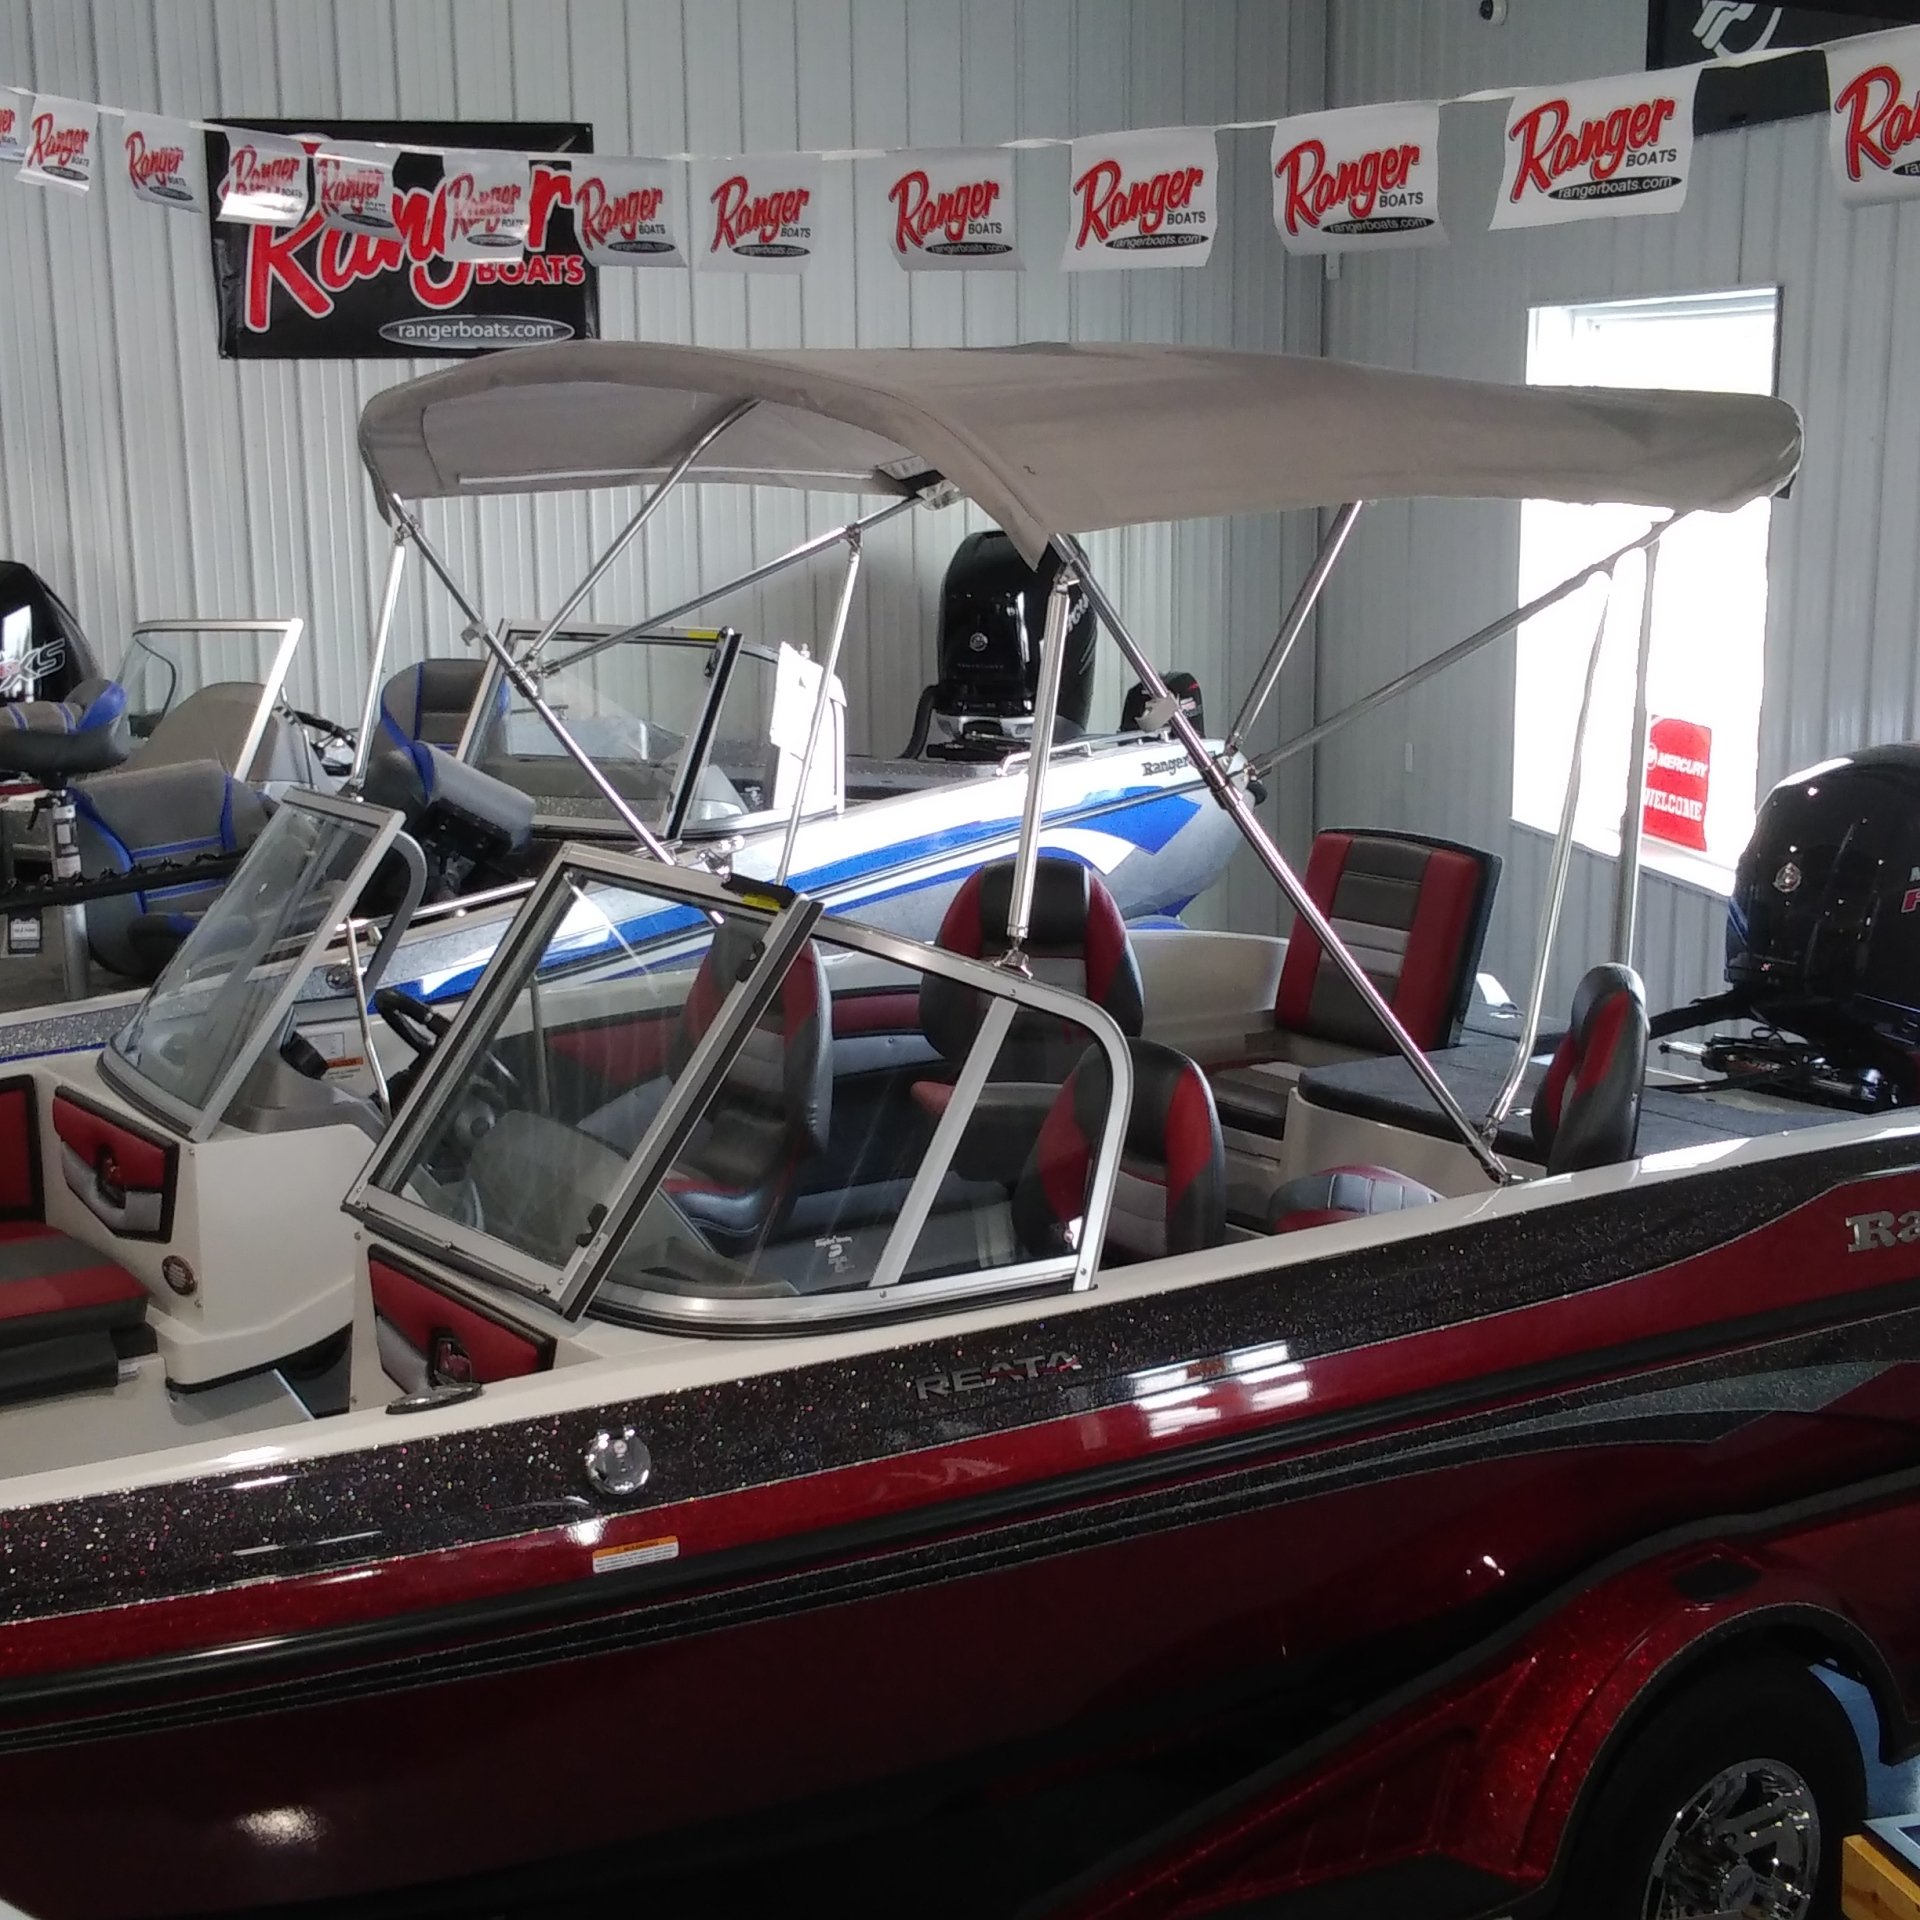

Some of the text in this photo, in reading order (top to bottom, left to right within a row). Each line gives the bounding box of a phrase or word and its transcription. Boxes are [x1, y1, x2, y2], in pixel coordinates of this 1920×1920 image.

[27, 112, 90, 168] Ranger
[1509, 97, 1676, 204] Ranger
[125, 131, 184, 190] Ranger
[1626, 148, 1677, 168] BOATS
[1275, 139, 1422, 236] Ranger
[1379, 191, 1424, 208] BOATS
[1557, 174, 1673, 199] rangerboats.com
[575, 177, 663, 251] Ranger
[710, 175, 810, 253] Ranger
[888, 170, 999, 254] Ranger
[1073, 160, 1204, 251] Ranger
[1167, 211, 1206, 225] BOATS
[638, 224, 665, 234] BOATS
[780, 227, 811, 238] BOATS
[968, 222, 1002, 234] BOATS
[1329, 216, 1428, 234] rangerboats.com
[1111, 234, 1200, 248] rangerboats.com
[476, 255, 585, 285] BOATS
[398, 320, 555, 342] rangerboats.com
[1141, 755, 1190, 776] Ranger
[1657, 752, 1708, 778] MERCURY
[1645, 788, 1703, 822] WELCOME
[914, 1351, 1083, 1400] REATA
